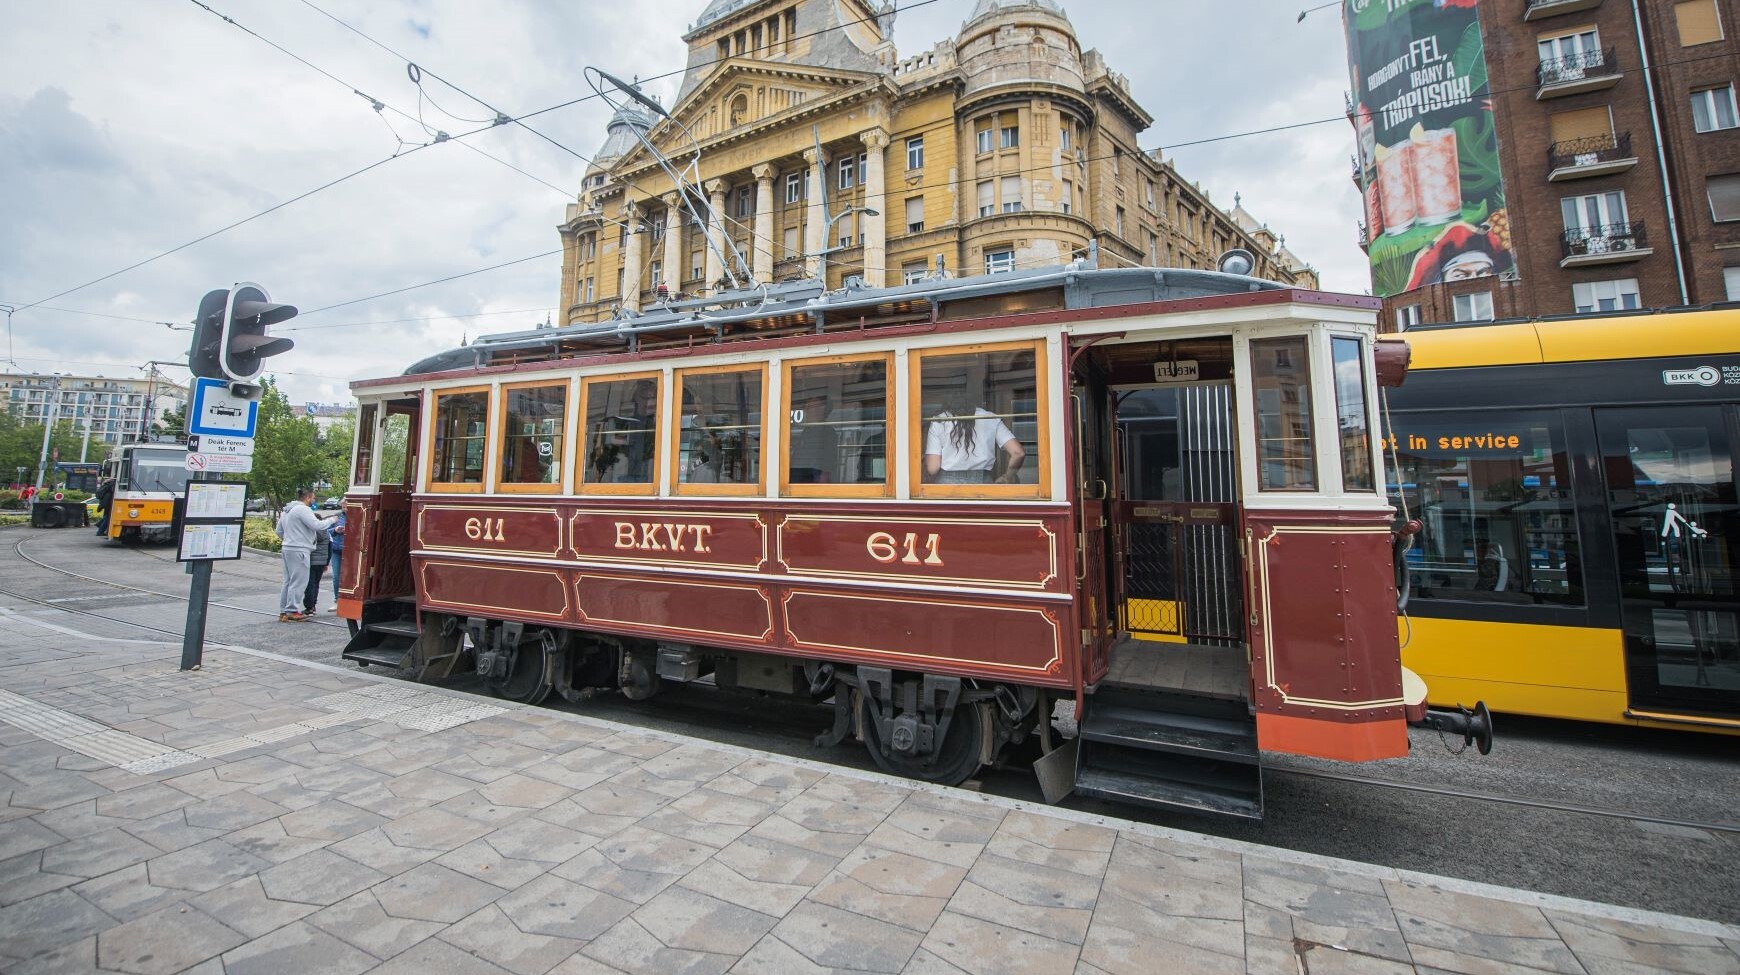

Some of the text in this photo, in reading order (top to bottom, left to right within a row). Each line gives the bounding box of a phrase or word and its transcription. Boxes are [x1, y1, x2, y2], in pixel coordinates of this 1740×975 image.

[1368, 35, 1448, 92] HORGONYT FEL,
[1410, 61, 1455, 88] IRÁNY A
[1380, 75, 1472, 131] TRÓPUSOK!
[1157, 366, 1197, 377] MEGELT
[1409, 434, 1427, 450] in
[1438, 433, 1520, 449] service
[465, 517, 506, 542] 611
[614, 521, 712, 553] B.K.V.T.
[866, 531, 945, 566] 611
